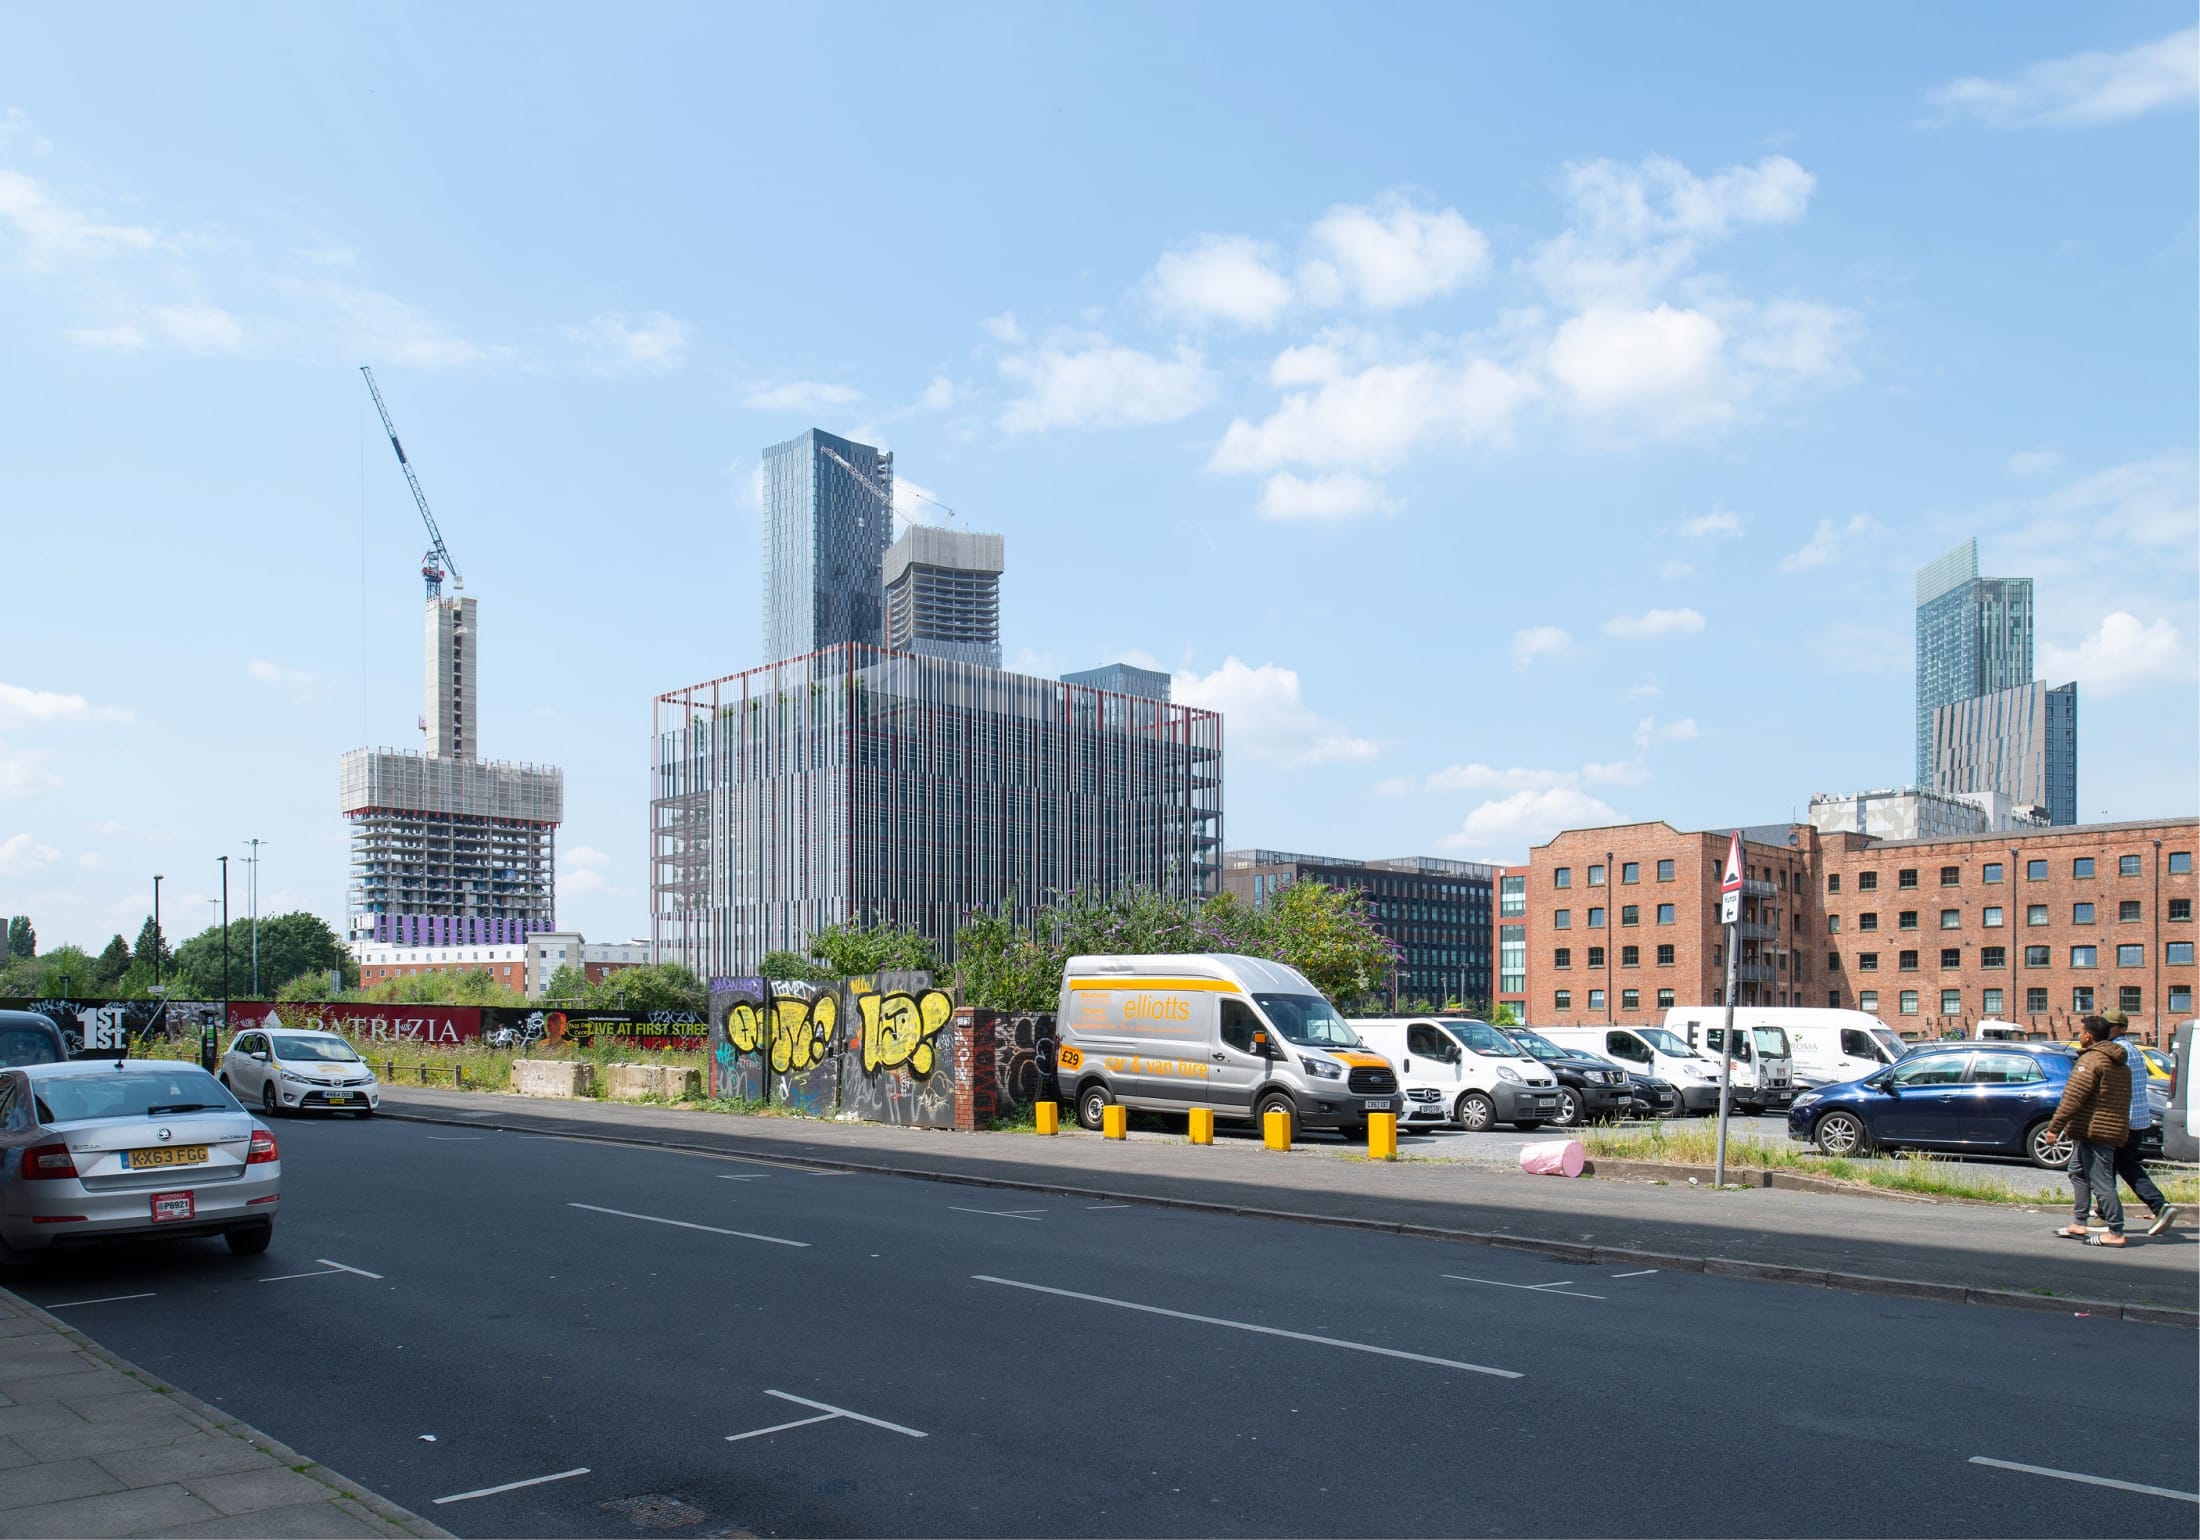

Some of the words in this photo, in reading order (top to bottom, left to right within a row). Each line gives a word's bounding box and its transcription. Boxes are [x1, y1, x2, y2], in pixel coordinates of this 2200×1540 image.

[1123, 993, 1191, 1022] elliotts
[617, 1022, 633, 1035] AT
[635, 1023, 668, 1036] FIRST
[671, 1023, 709, 1036] STREE
[1061, 1050, 1079, 1066] £29
[1104, 1056, 1128, 1072] car
[1130, 1055, 1142, 1073] &
[1145, 1059, 1173, 1074] van
[1176, 1056, 1209, 1079] hire
[132, 1151, 173, 1165] KX63
[177, 1148, 207, 1162] FGG
[164, 1200, 189, 1210] P6921
